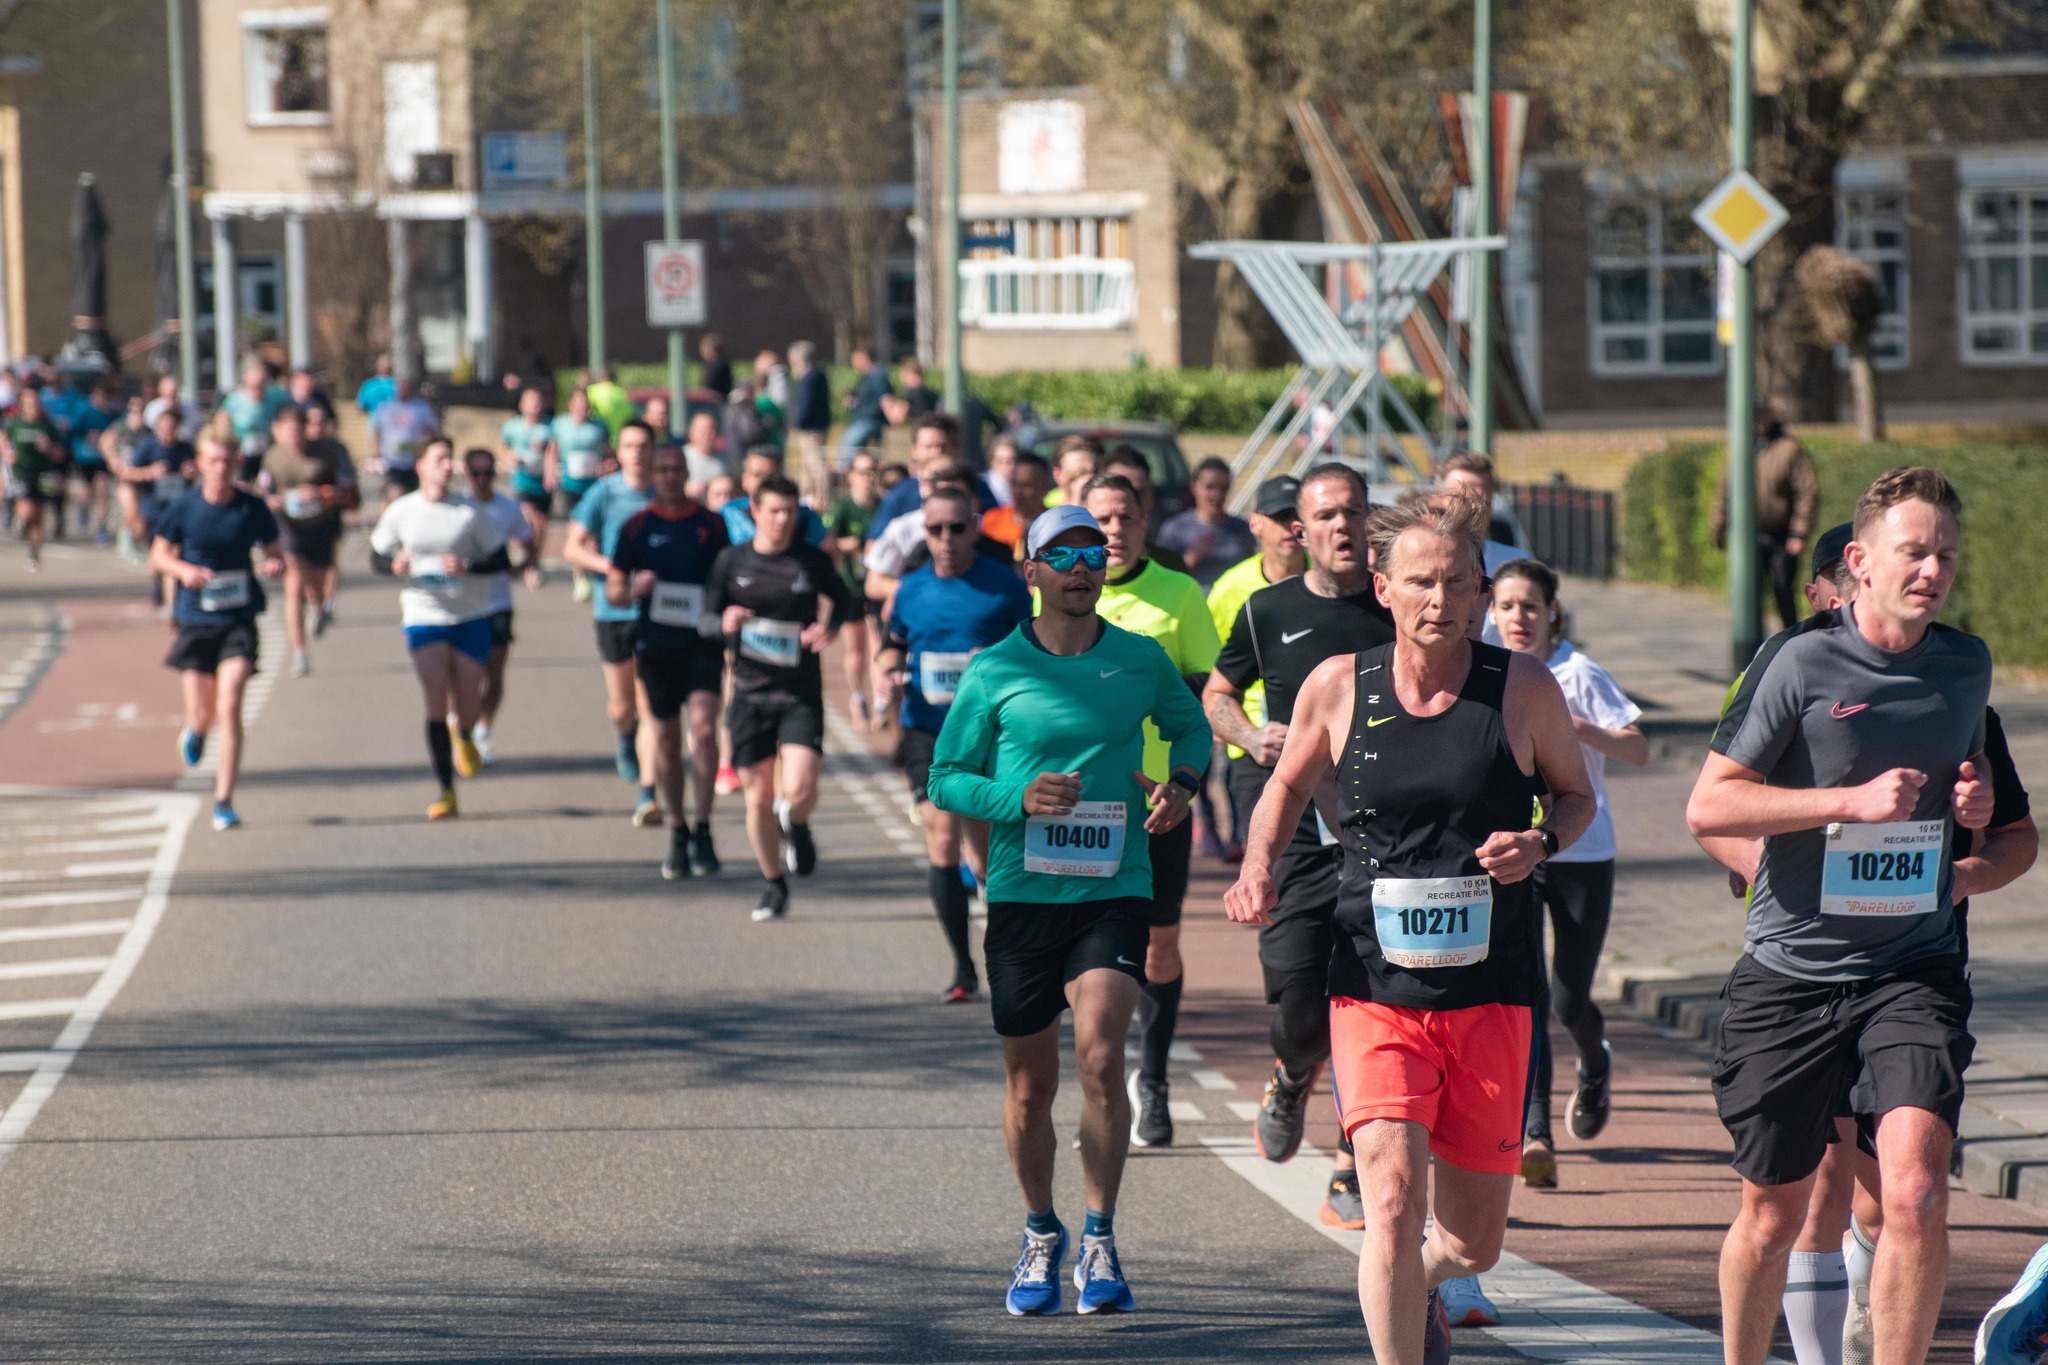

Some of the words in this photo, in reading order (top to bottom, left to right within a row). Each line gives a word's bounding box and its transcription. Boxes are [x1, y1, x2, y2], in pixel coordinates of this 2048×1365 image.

[1365, 694, 1380, 868] NIKE
[1919, 825, 1928, 833] 10
[1930, 823, 1941, 832] KM
[1044, 825, 1110, 849] 10400
[1884, 836, 1926, 844] RECREATIE
[1042, 862, 1104, 875] PARELLOOP
[1848, 852, 1924, 881] 10284
[1463, 880, 1473, 888] 10
[1475, 879, 1488, 887] KM
[1427, 891, 1472, 900] RECREATIE
[1473, 889, 1489, 897] RUN
[1845, 901, 1917, 913] PARELLOOP
[1398, 907, 1469, 935] 10271
[1397, 953, 1468, 966] PARELLOOP
